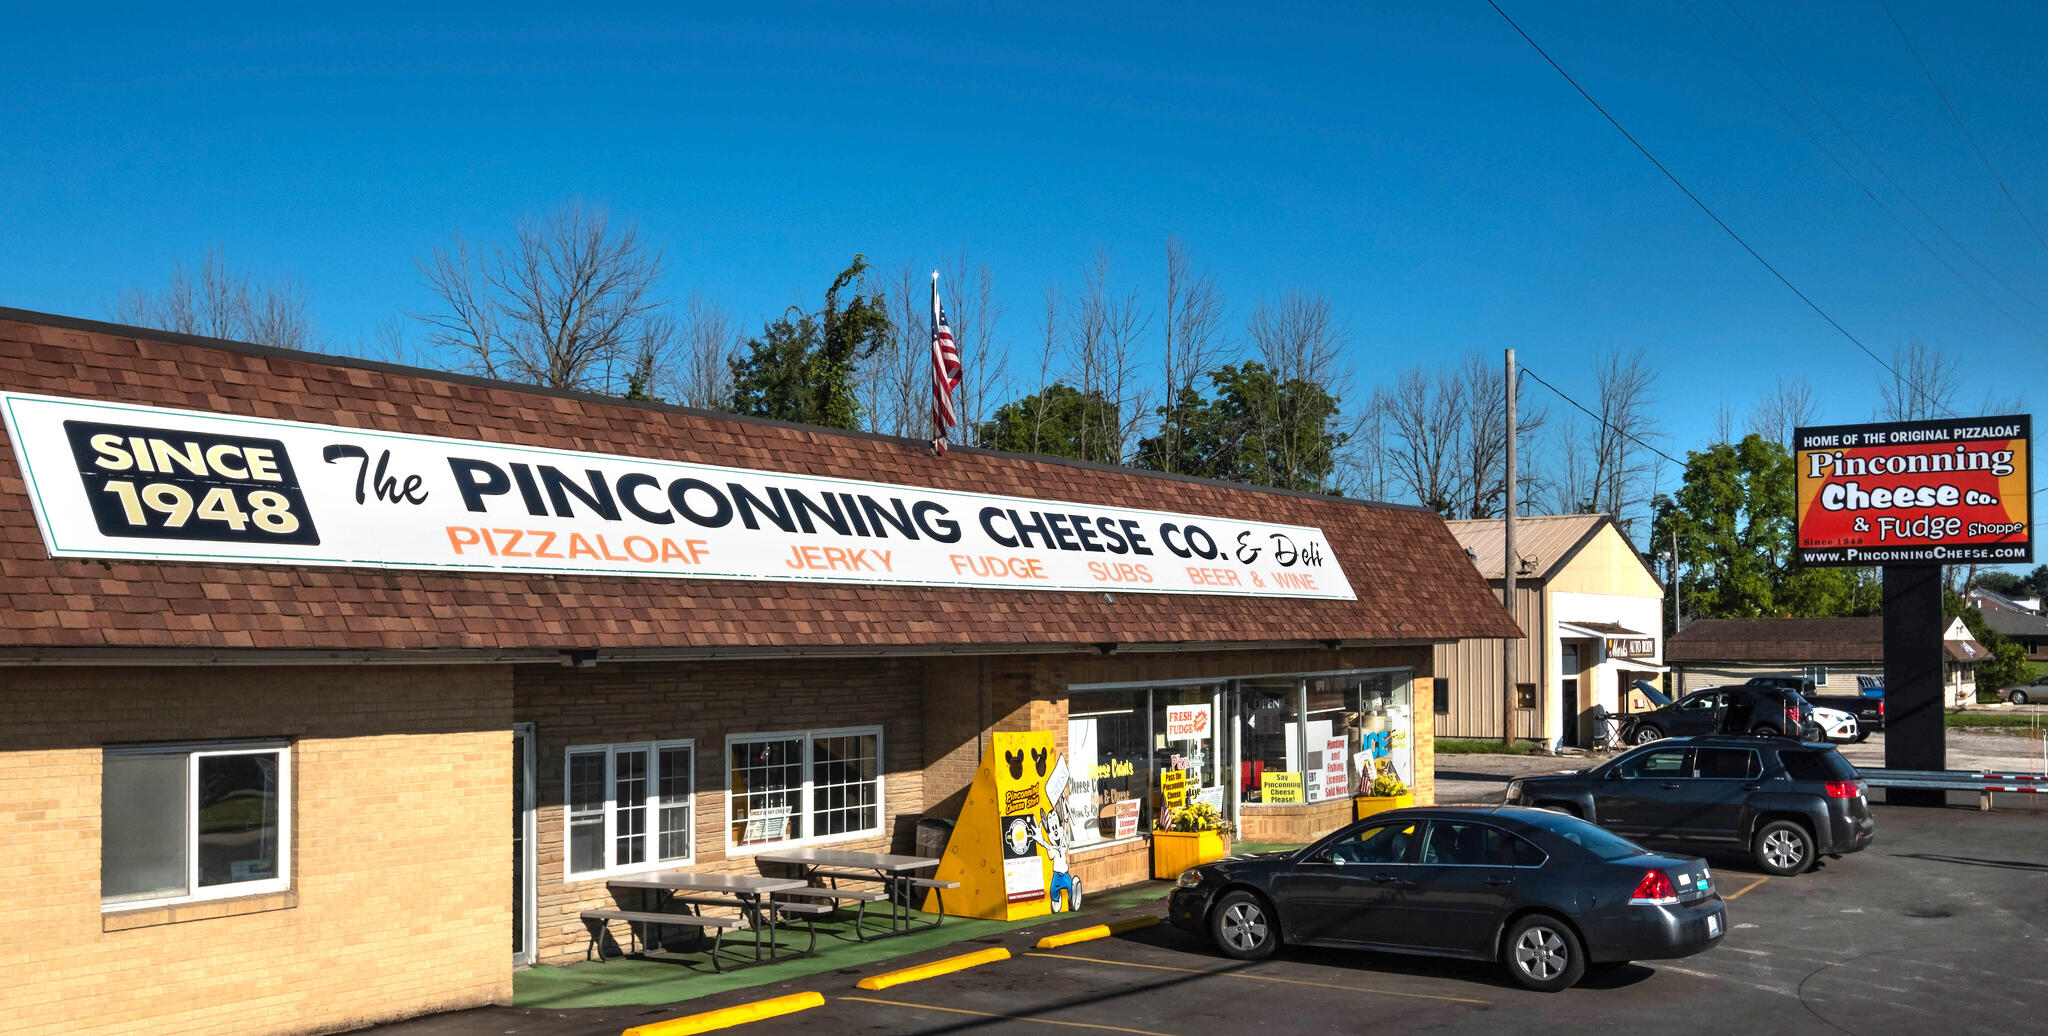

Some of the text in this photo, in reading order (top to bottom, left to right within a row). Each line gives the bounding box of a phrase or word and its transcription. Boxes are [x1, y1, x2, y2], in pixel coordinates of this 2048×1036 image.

[1804, 425, 2020, 448] HOME OF THE ORIGINAL PIZZALOAF
[91, 435, 282, 481] SINCE
[1808, 446, 2014, 478] Pinconning
[104, 481, 299, 533] 1948
[323, 445, 1324, 569] The PINCONNING CHEESE CO. & Deli
[1822, 482, 1960, 511] Cheese
[1803, 538, 1832, 546] Since
[1854, 515, 2023, 540] & Fudge Shoppe
[446, 526, 1319, 591] PIZZALOAF JERKY FUDGE SUBS BEER & WINE
[1169, 711, 1192, 722] FRESH
[1169, 724, 1193, 735] FUDGE
[1363, 730, 1388, 759] ICE
[1327, 762, 1343, 773] Fishing
